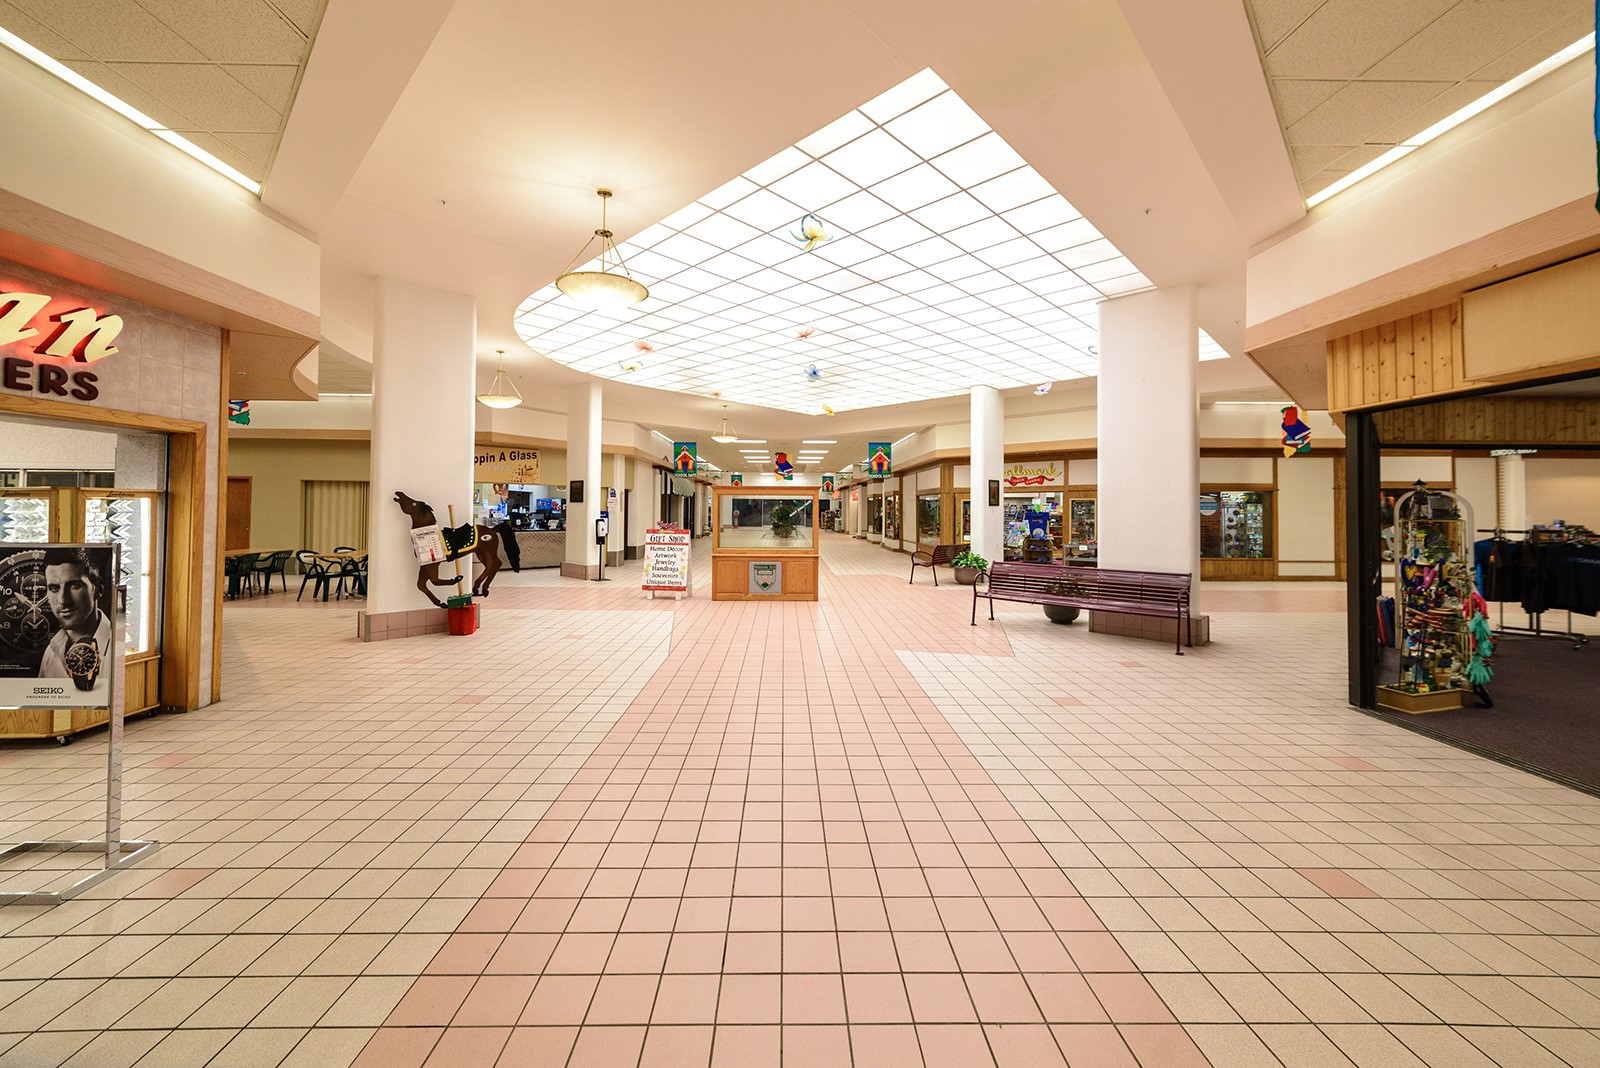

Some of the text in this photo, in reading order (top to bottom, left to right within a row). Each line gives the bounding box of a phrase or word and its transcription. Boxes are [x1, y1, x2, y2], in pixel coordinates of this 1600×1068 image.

[4, 357, 99, 401] ERS
[499, 451, 506, 462] A
[509, 450, 537, 461] Glass
[650, 534, 686, 543] GIFT SHOP
[654, 559, 676, 567] Jewelry
[651, 565, 679, 573] Handbags
